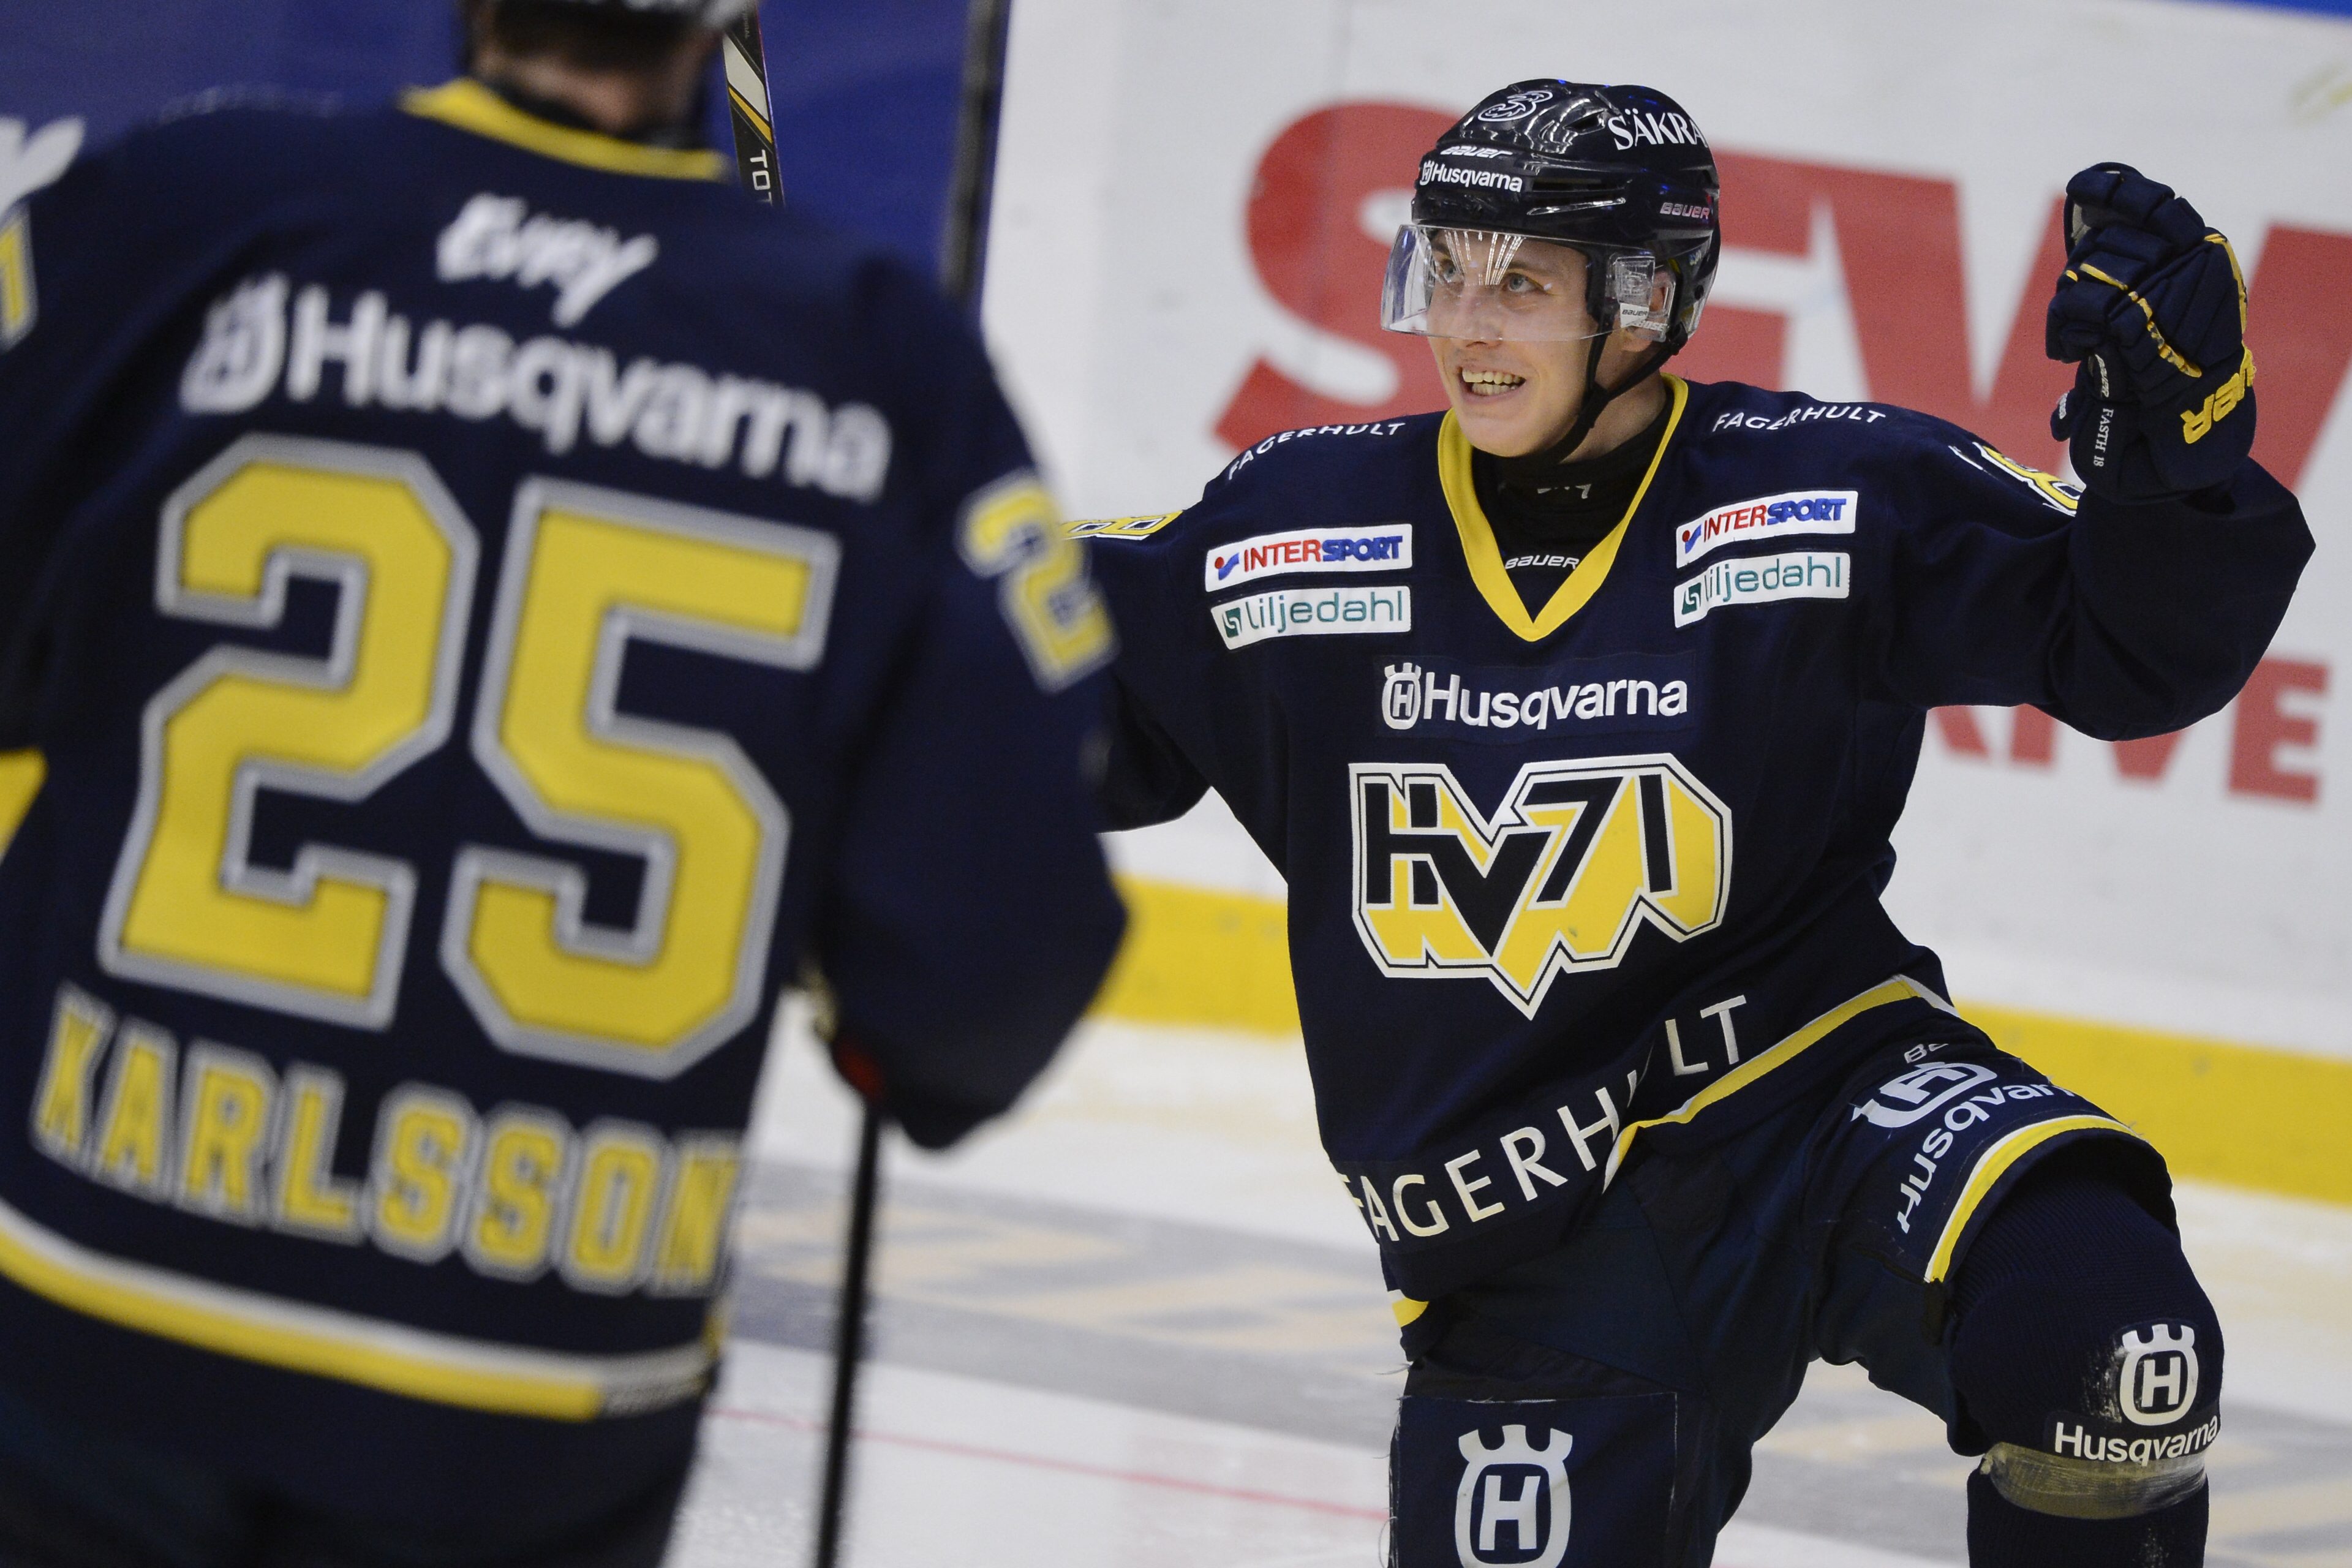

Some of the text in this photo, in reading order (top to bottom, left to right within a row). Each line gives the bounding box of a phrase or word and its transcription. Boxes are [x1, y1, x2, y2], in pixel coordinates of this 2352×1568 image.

[1432, 164, 1523, 192] Husqvarna
[284, 282, 894, 505] Husqvarna
[1713, 405, 1886, 432] FAGERHULT
[1229, 423, 1406, 480] FAGERHULT
[2095, 408, 2114, 453] FASTH
[1704, 499, 1846, 543] INTERSPORT
[1244, 536, 1403, 572] INTERSPORT
[1423, 671, 1687, 730] Husqvarna
[98, 430, 844, 1079] 25
[29, 980, 746, 1298] KARLSSON
[1338, 995, 1747, 1242] AGERHLT
[2054, 1415, 2218, 1467] Husqvarna
